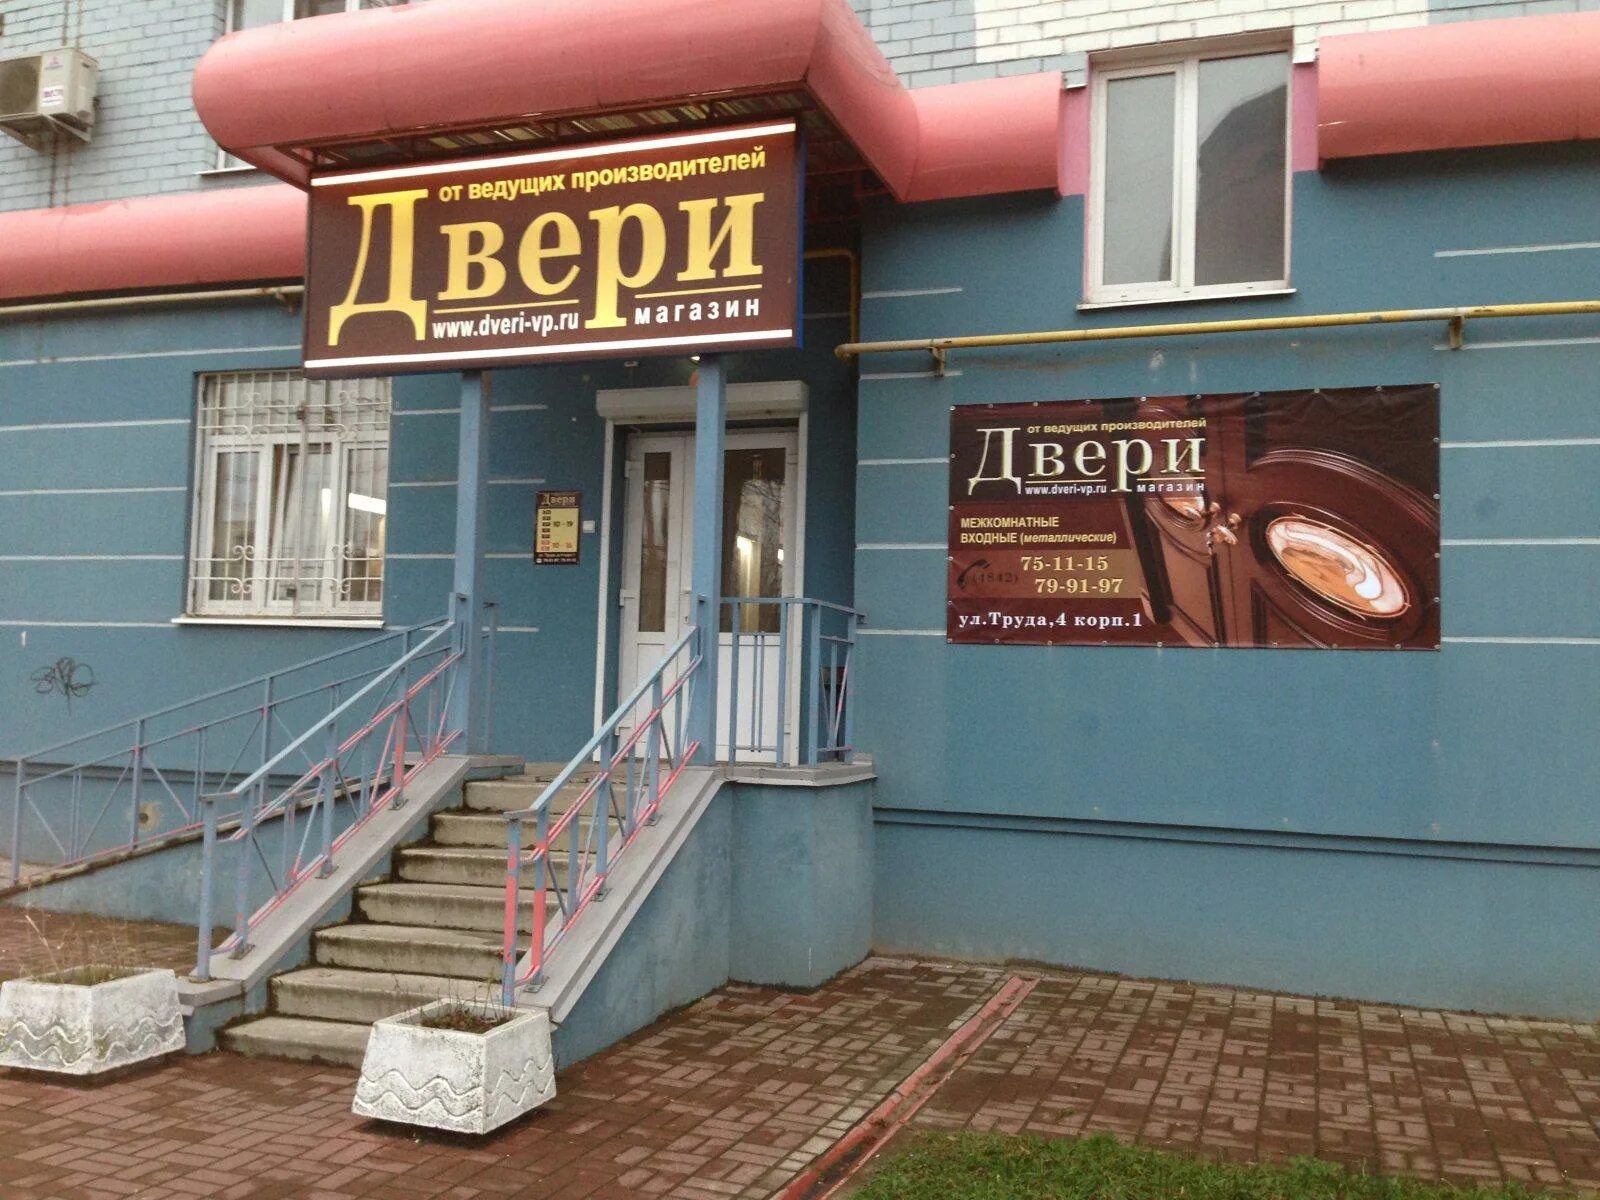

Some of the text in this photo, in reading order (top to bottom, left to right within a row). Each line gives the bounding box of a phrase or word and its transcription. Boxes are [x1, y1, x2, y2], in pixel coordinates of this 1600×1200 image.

[439, 146, 766, 202] от ведущих производителей
[328, 189, 765, 346] Двери
[634, 299, 760, 325] магазин
[432, 310, 580, 338] www.dveri-vp.ru
[1027, 418, 1207, 435] от ведущих производителей
[967, 427, 1206, 496] Двери
[1025, 483, 1107, 496] www.dveri-vp.ru
[1137, 482, 1205, 493] магазин
[960, 516, 1060, 529] МЕЖКОМНАТНЫЕ
[960, 532, 1117, 545] ВХОДНЫЕ (металлические)
[1020, 556, 1109, 571] 75-11-15
[1035, 578, 1124, 593] 79-91-97
[958, 612, 1143, 629] ул.Труда,4 корп.1
